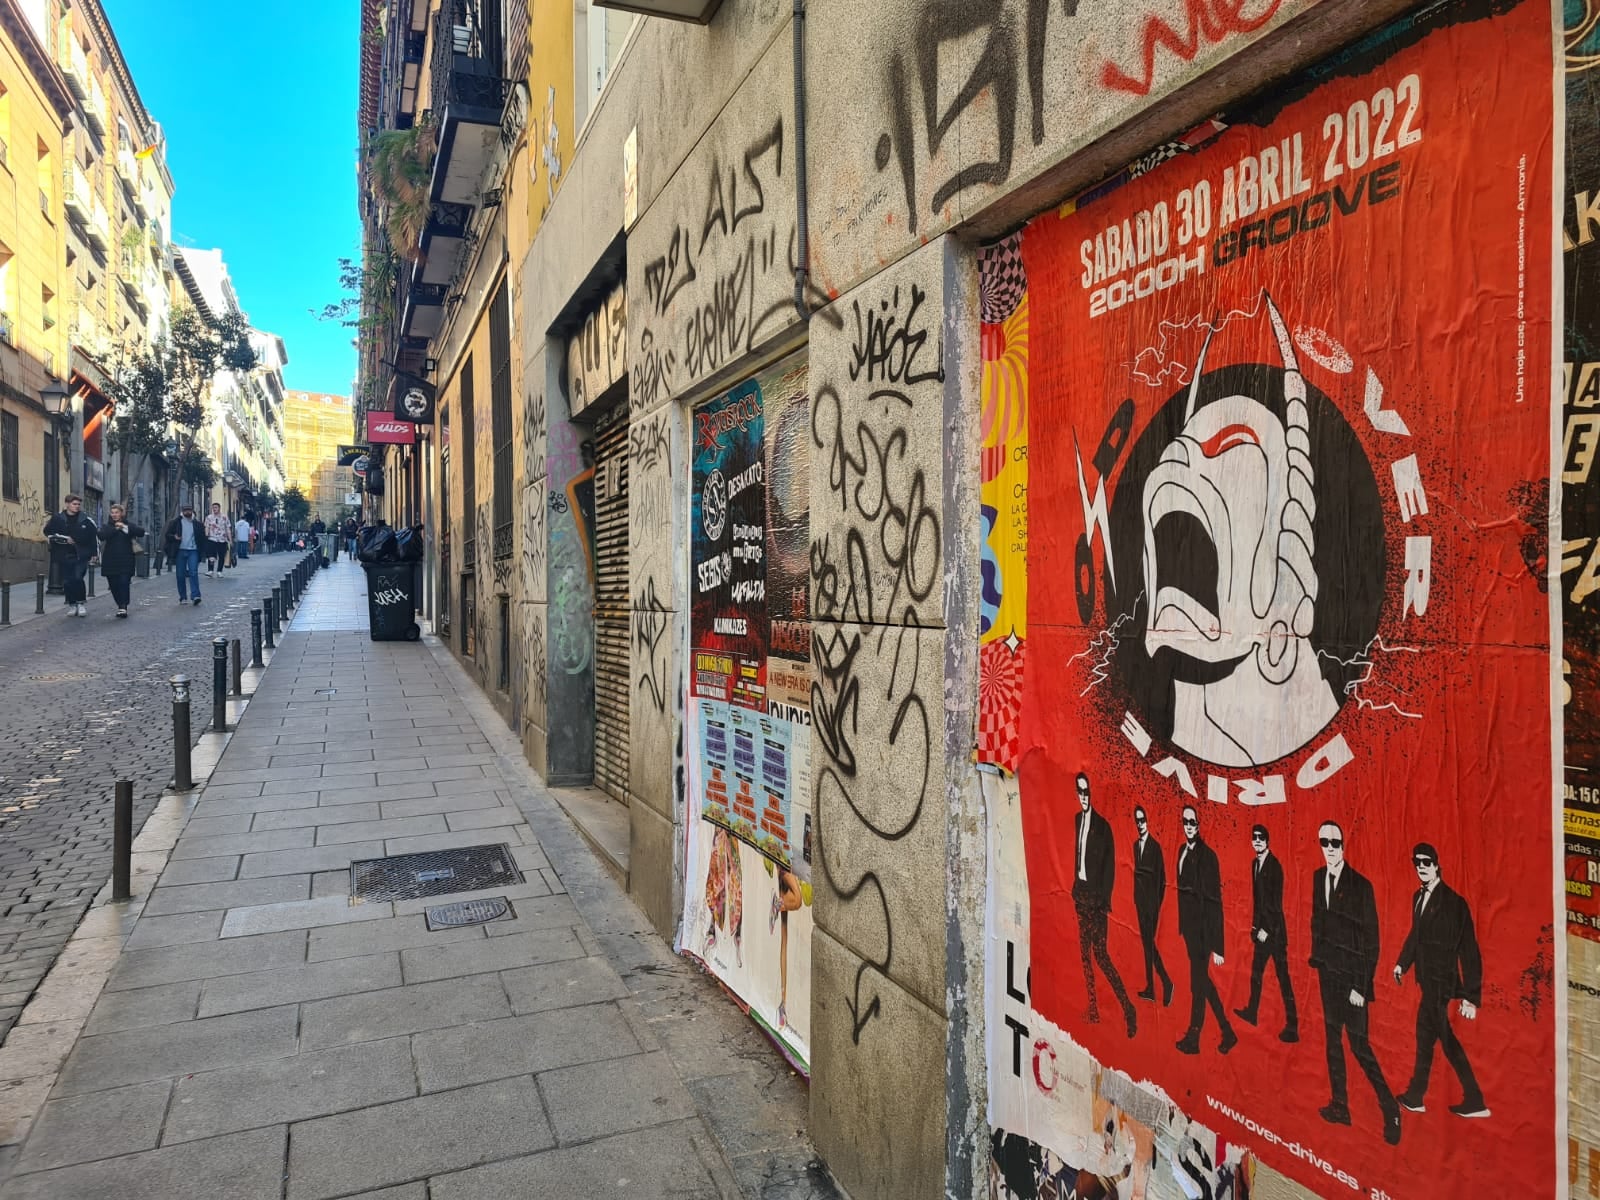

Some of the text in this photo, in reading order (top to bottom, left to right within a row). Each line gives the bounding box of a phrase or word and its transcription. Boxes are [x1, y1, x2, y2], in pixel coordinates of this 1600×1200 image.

[1080, 73, 1424, 289] SABADO 30 ABRIL 2022
[1212, 161, 1401, 268] GROOVE
[1088, 244, 1206, 319] 20:00H
[1517, 274, 1526, 289] se
[1517, 291, 1526, 319] otra
[1517, 320, 1526, 348] cae,
[1516, 349, 1526, 375] hoja
[1515, 376, 1526, 403] Una
[373, 423, 410, 433] MALOS
[727, 460, 763, 500] DESAKATO
[1578, 786, 1591, 803] 15
[1206, 1094, 1360, 1191] www.over-drive.es
